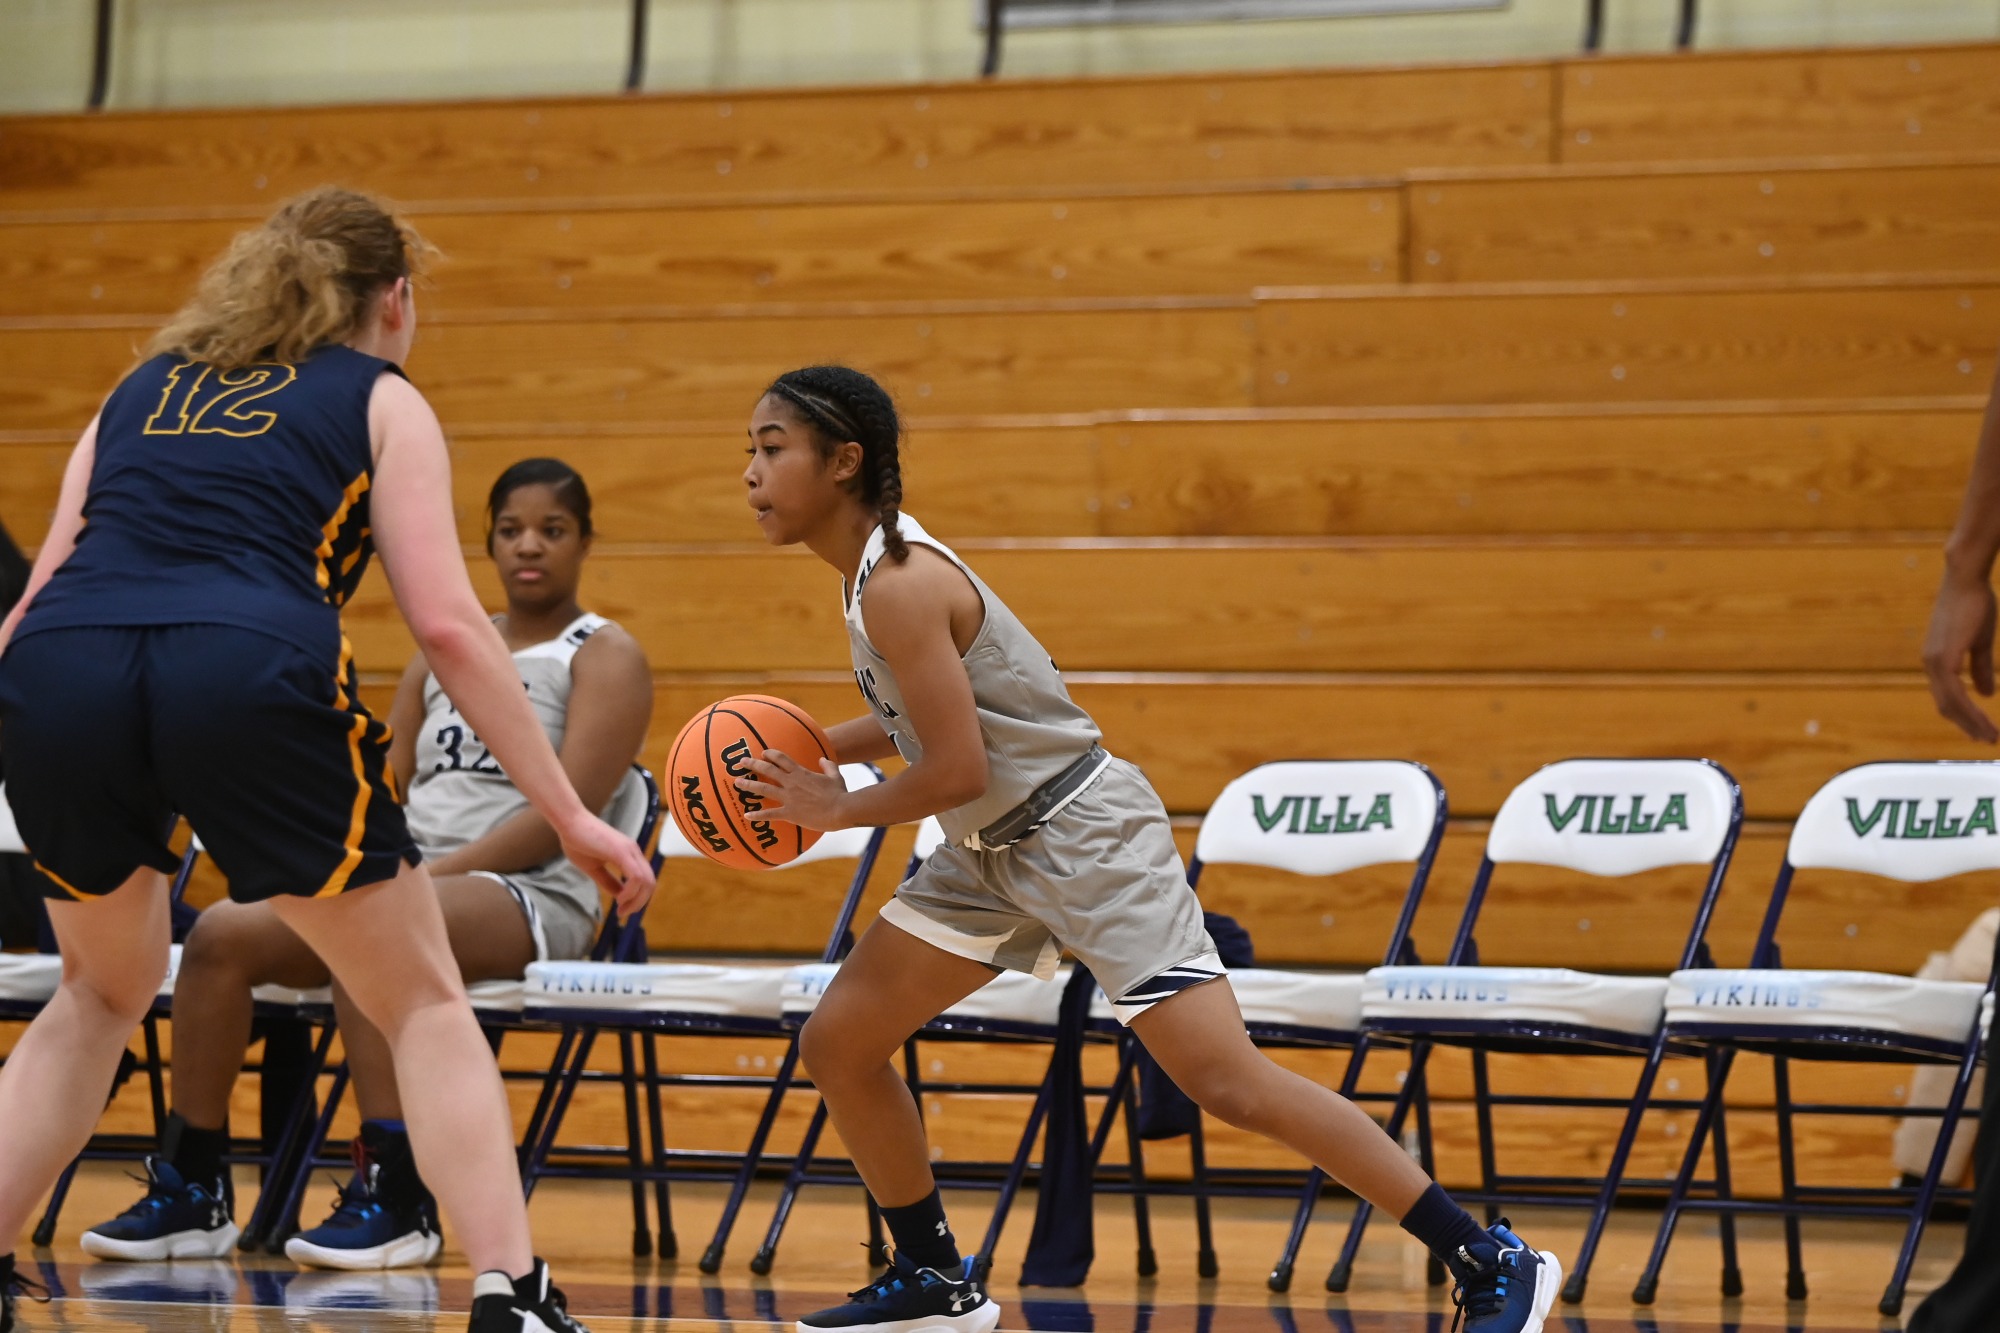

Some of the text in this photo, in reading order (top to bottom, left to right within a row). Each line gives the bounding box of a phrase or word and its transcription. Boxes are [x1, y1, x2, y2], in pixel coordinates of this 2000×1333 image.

[143, 361, 297, 437] 12
[681, 775, 731, 853] NCAA
[1250, 793, 1393, 834] VILLA
[1543, 793, 1688, 834] VILLA
[1844, 797, 1998, 839] VILLA
